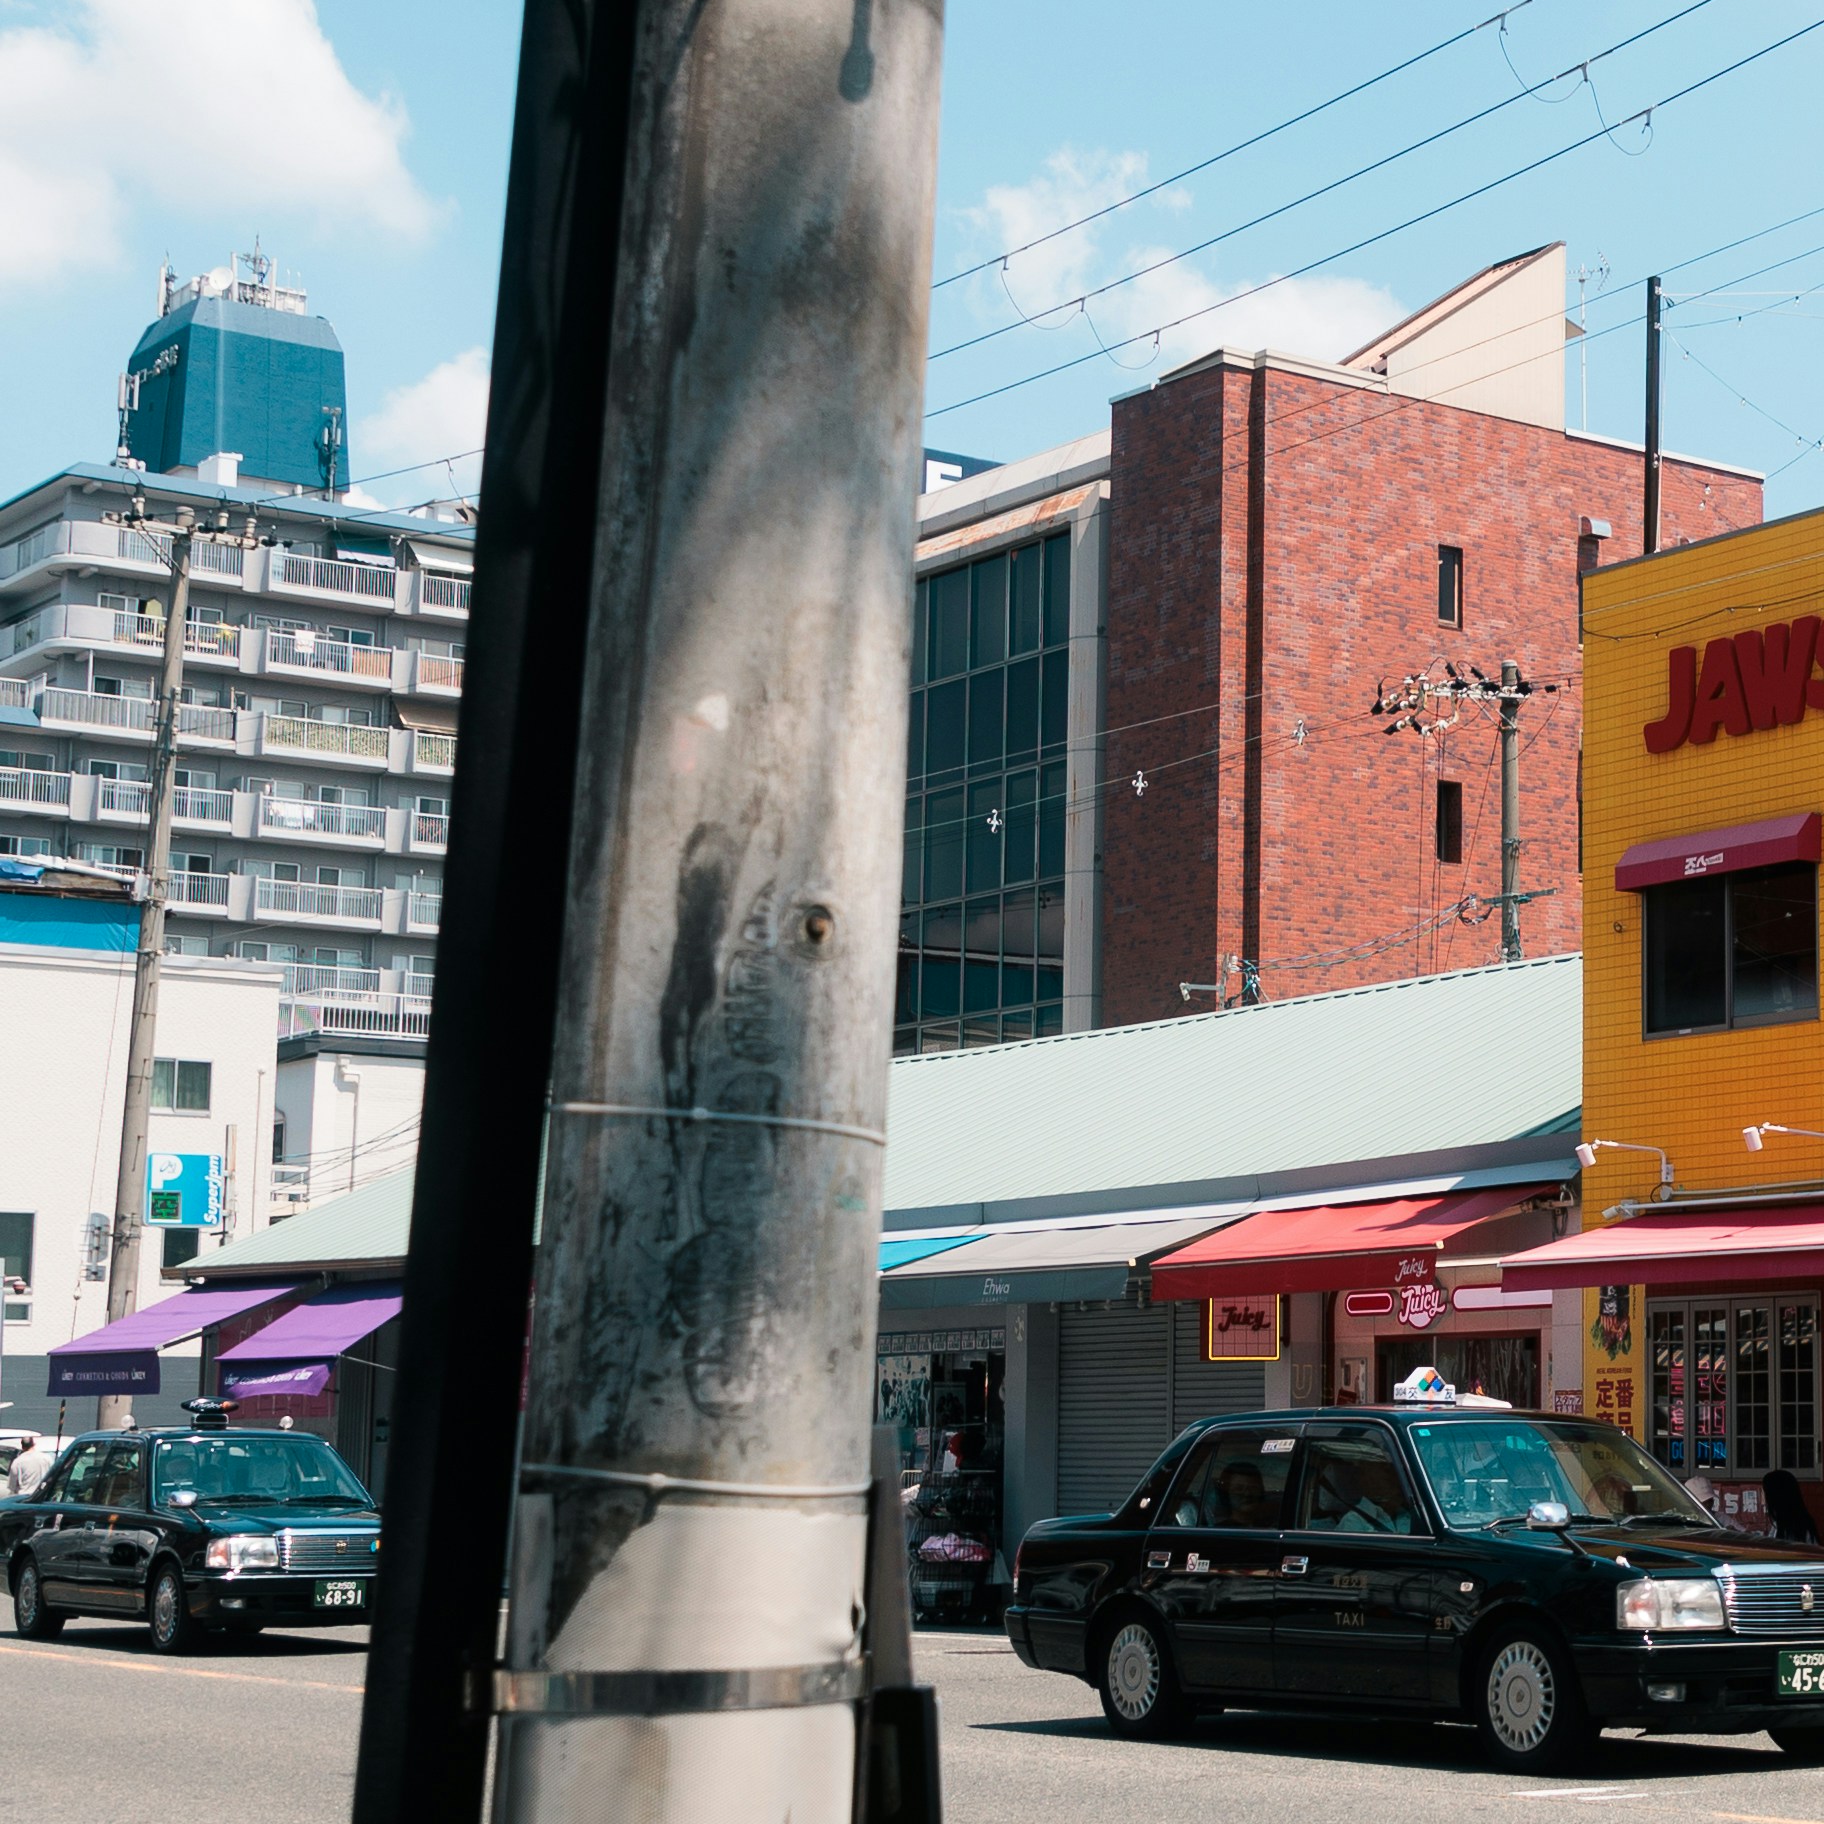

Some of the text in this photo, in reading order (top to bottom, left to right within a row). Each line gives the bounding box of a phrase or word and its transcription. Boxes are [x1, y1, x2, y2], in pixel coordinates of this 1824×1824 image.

[1394, 1257, 1429, 1283] Juicy
[982, 1277, 1011, 1296] Ehwa
[1400, 1284, 1447, 1325] Juicy
[1217, 1306, 1272, 1333] Juicy
[1595, 1378, 1634, 1409] 定番
[325, 1589, 362, 1605] 68-91
[1334, 1611, 1365, 1627] TAXI
[1781, 1674, 1791, 1686] い
